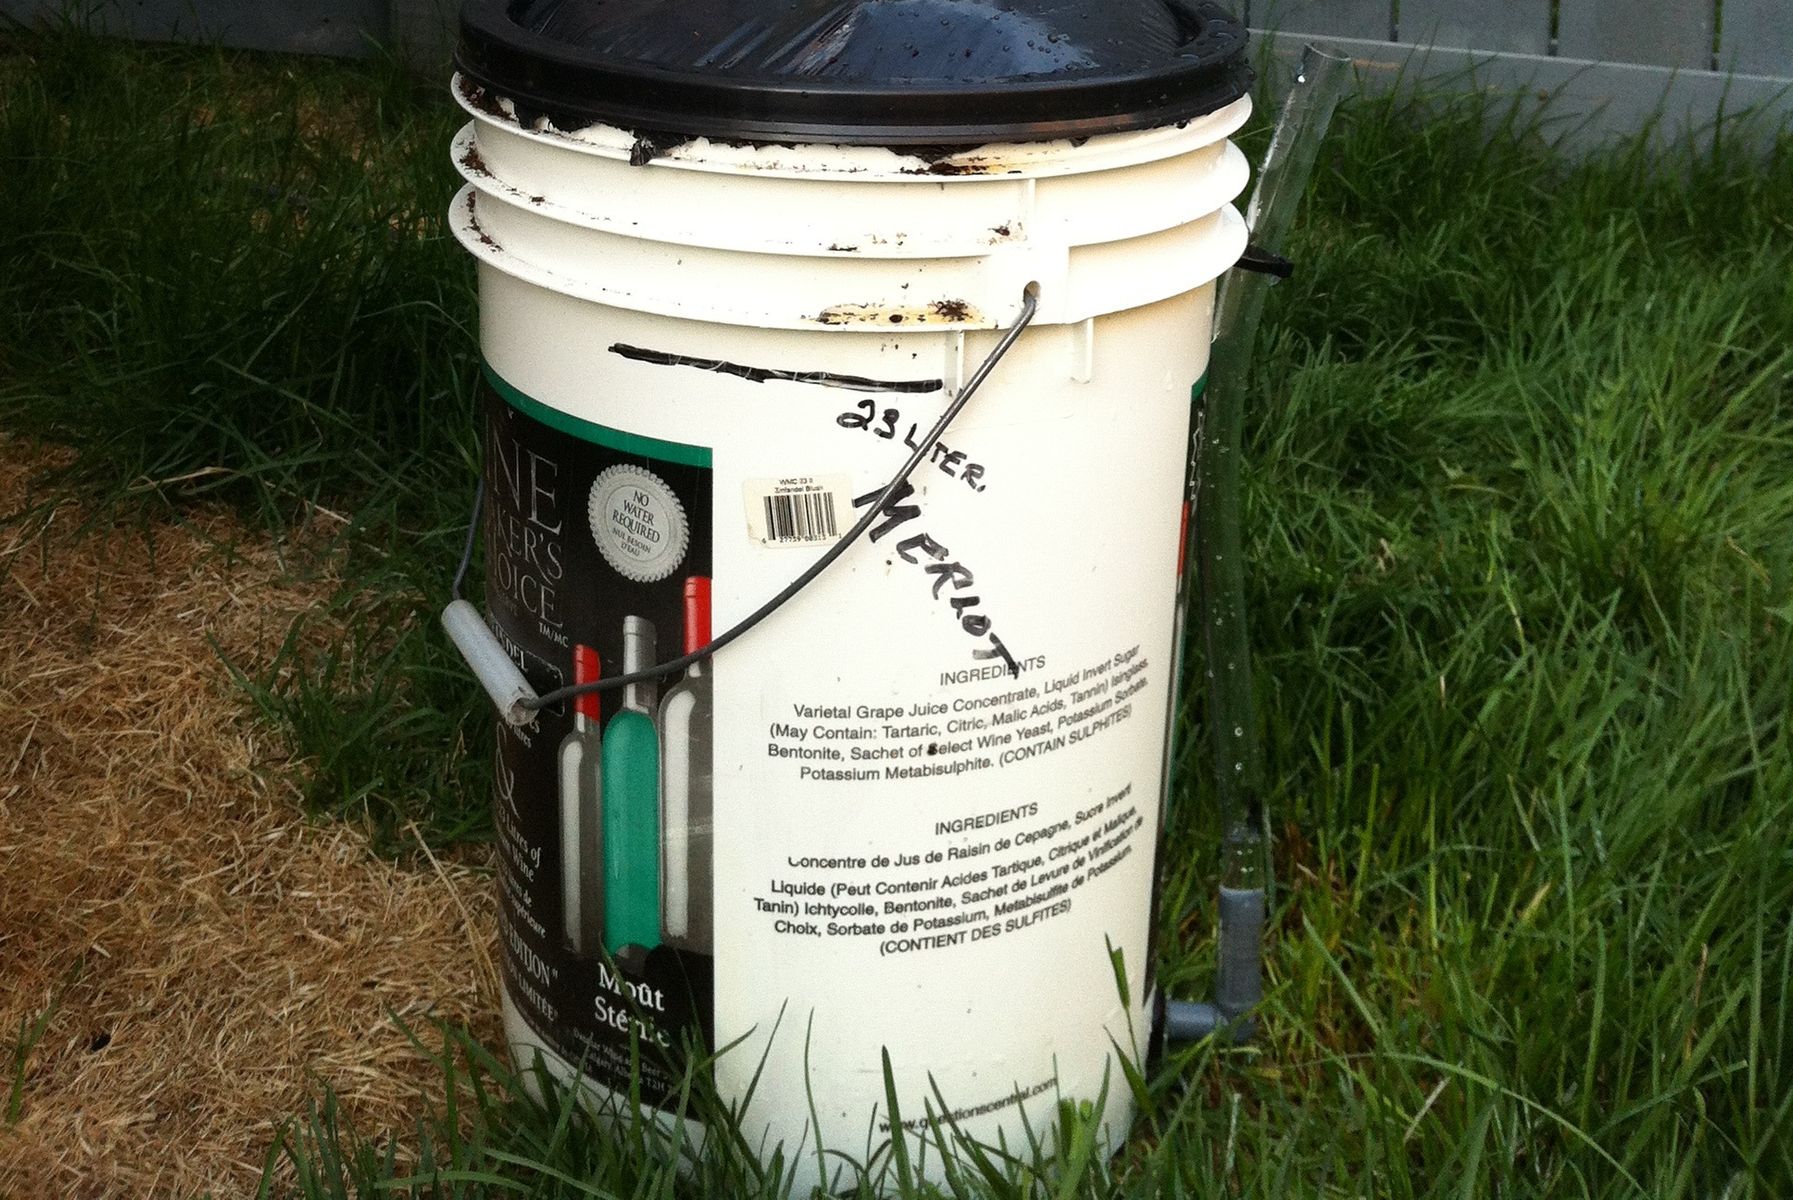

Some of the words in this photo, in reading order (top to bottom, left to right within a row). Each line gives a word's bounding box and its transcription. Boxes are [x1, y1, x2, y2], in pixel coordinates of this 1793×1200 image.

[836, 399, 899, 439] 23
[904, 423, 986, 492] LTER.
[612, 508, 660, 544] REQUIRED
[623, 499, 654, 527] WATER
[632, 490, 650, 507] NO
[495, 503, 563, 586] KER'S
[495, 552, 563, 629] OICE
[793, 703, 851, 719] Varietal
[856, 705, 904, 721] Grape
[908, 702, 948, 717] Juice
[953, 686, 1040, 712] Concentrate,
[1044, 672, 1080, 695] Liquid
[1082, 659, 1112, 681] Invert
[1113, 644, 1140, 667] Sugar
[940, 655, 1046, 686] INGREDIENTS
[768, 743, 845, 762] Bentonite,
[850, 747, 904, 760] Sachet
[908, 744, 923, 758] of
[926, 738, 973, 756] Select
[977, 731, 1012, 749] Wine
[1016, 720, 1054, 740] Yeast,
[1057, 697, 1113, 729] Potassium
[769, 722, 808, 741] (May
[813, 726, 877, 740] Contain:
[882, 723, 942, 738] Tartaric,
[947, 718, 988, 734] Citric,
[991, 709, 1027, 727] Malic
[1030, 699, 1067, 718] Acids,
[1070, 678, 1109, 705] Tannin)
[800, 766, 880, 781] Potassium
[885, 757, 994, 779] Metabisulphite.
[999, 735, 1066, 767] (CONTAIN
[1068, 703, 1133, 745] SULPHITES)
[871, 854, 890, 868] de
[894, 853, 920, 867] Jus
[924, 850, 943, 864] de
[947, 842, 990, 861] Raisin
[994, 836, 1011, 852] de
[1015, 818, 1071, 847] Cepagne,
[1075, 802, 1104, 825] Sucre
[935, 802, 1038, 836] INGREDIENTS
[530, 846, 542, 869] of
[753, 897, 799, 917] Tanin)
[884, 896, 956, 915] Bentonite,
[961, 884, 1008, 905] Sachet
[1011, 878, 1028, 893] de
[1030, 864, 1070, 887] Levure
[1073, 855, 1086, 871] de
[771, 879, 826, 898] Liquide
[831, 883, 871, 899] (Peut
[875, 877, 938, 895] Contenir
[941, 871, 988, 889] Acides
[1048, 835, 1090, 861] Citrique
[774, 919, 822, 937] Choix,
[826, 922, 886, 936] Sorbate
[890, 920, 909, 933] de
[913, 910, 989, 932] Potassium,
[1071, 873, 1085, 889] de
[880, 930, 967, 956] (CONTIENT
[971, 922, 1001, 941] DES
[1005, 897, 1072, 932] SULFITES)
